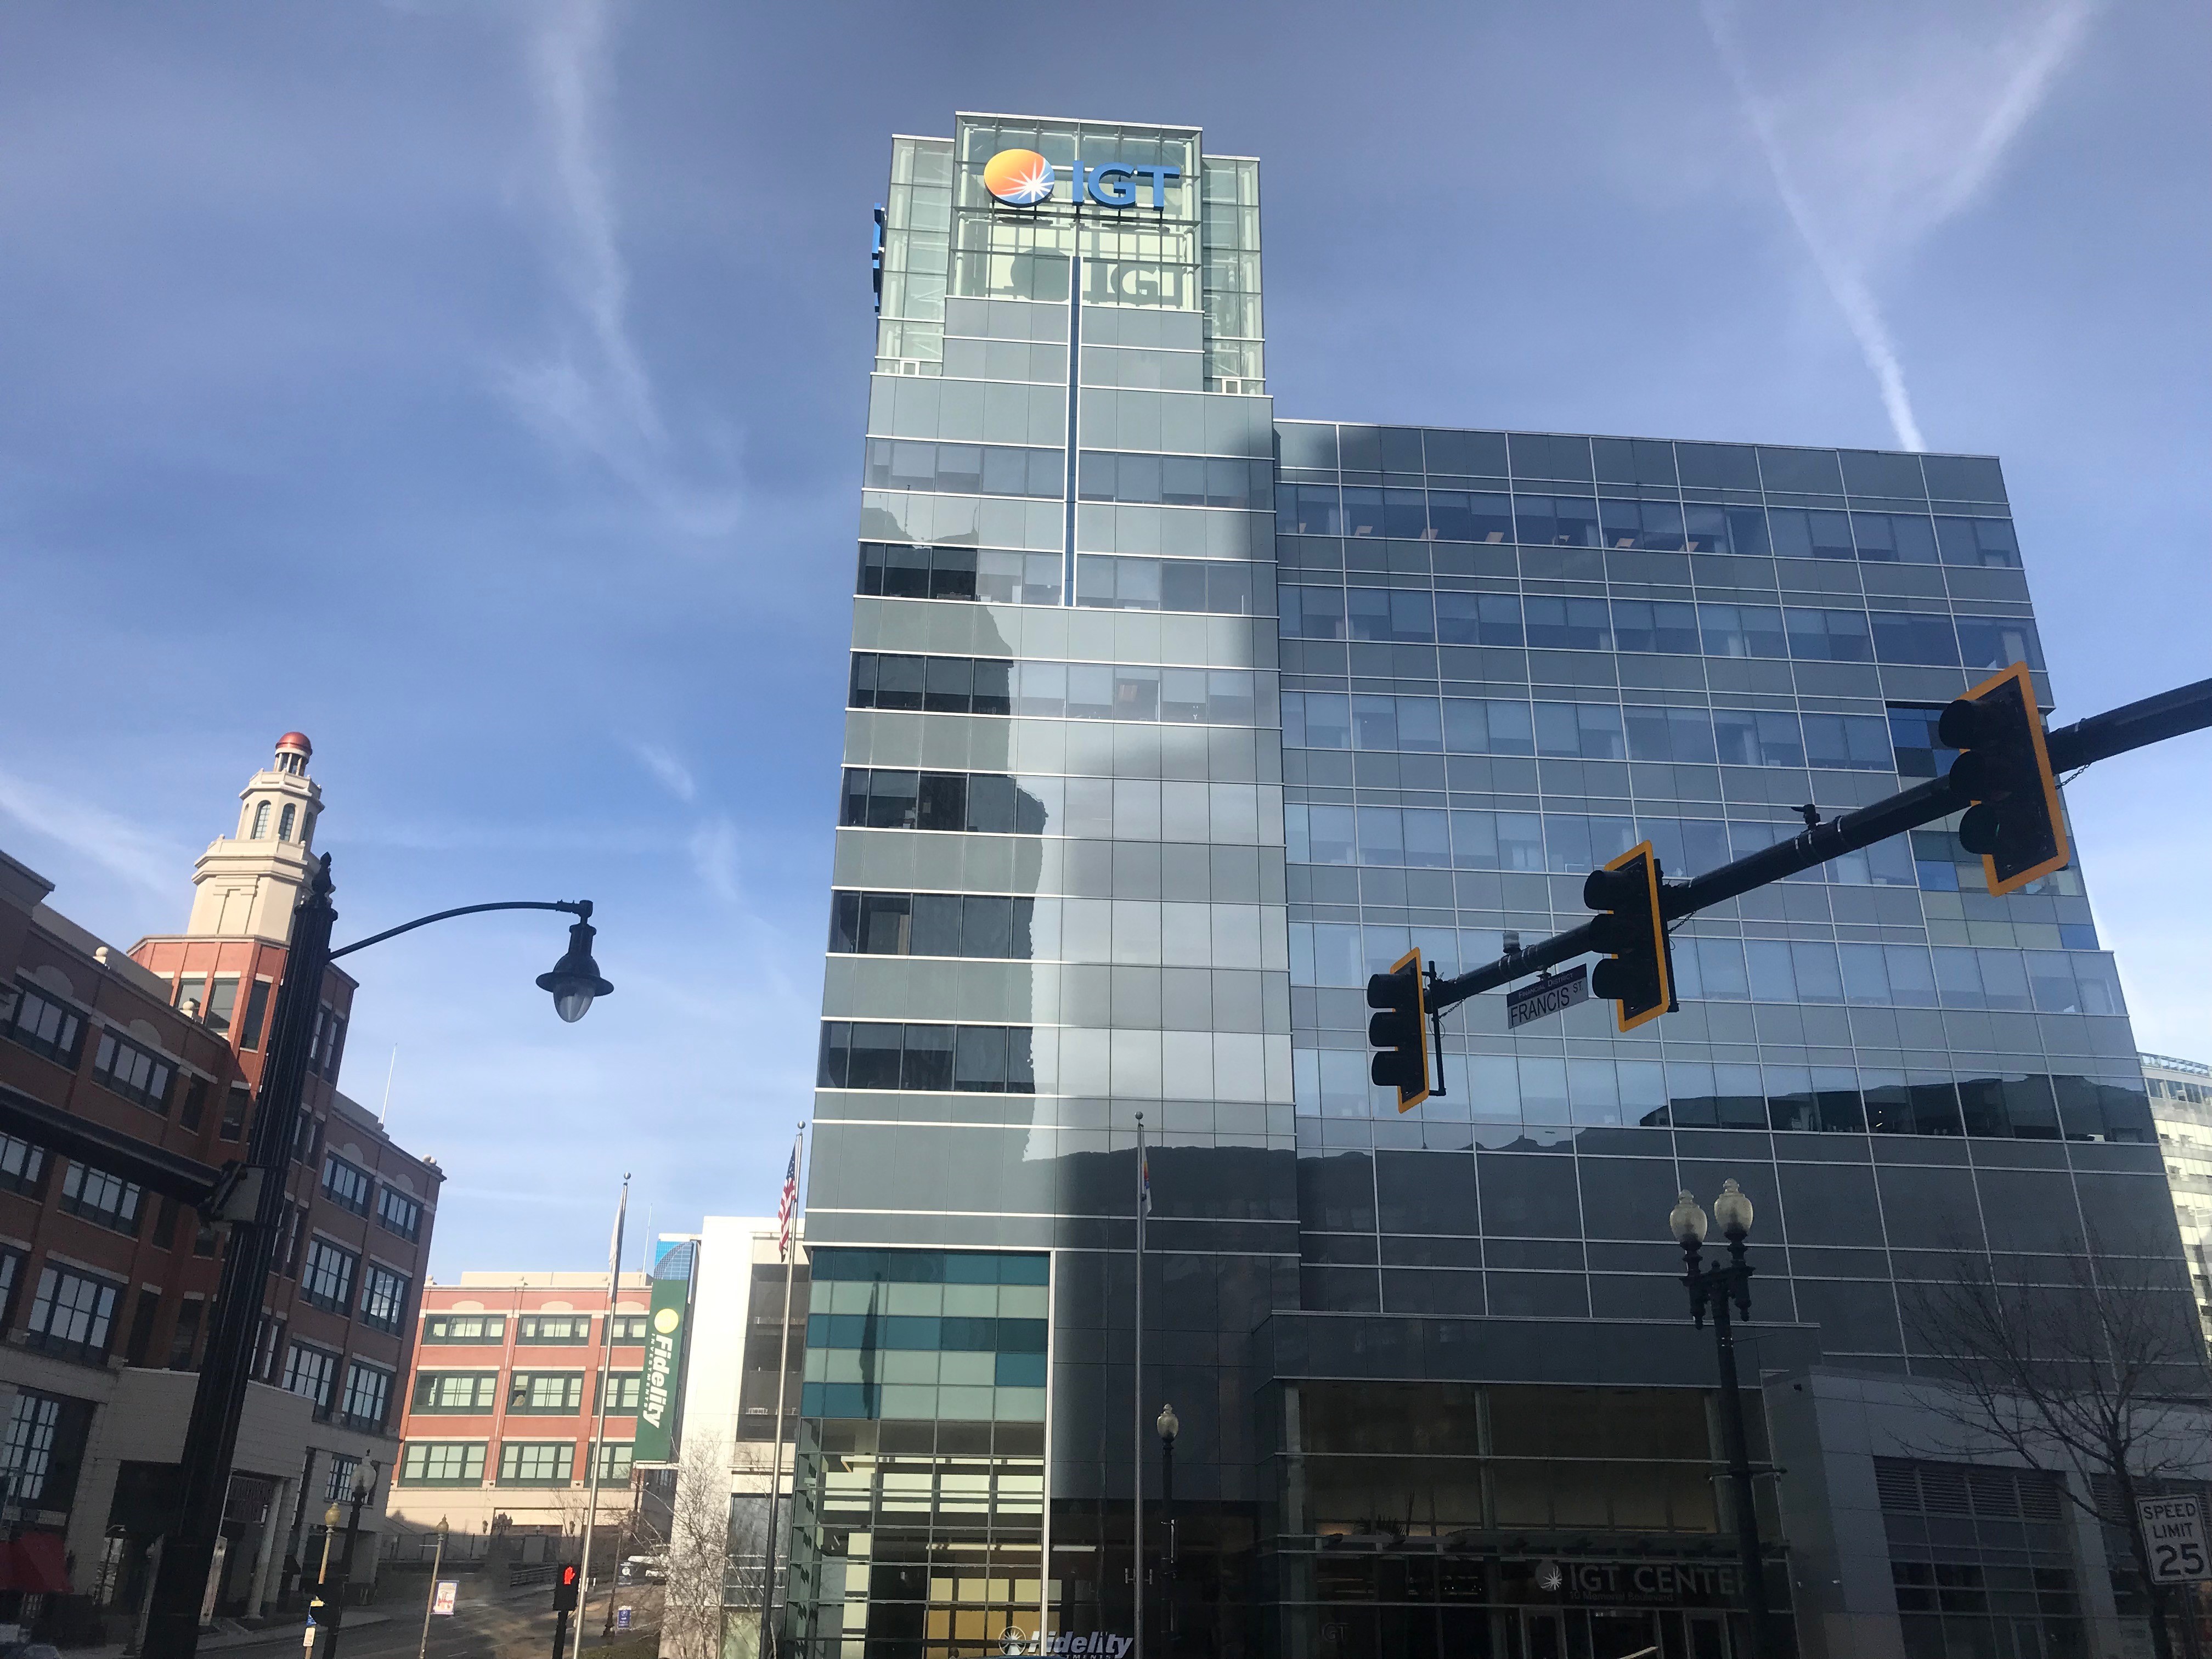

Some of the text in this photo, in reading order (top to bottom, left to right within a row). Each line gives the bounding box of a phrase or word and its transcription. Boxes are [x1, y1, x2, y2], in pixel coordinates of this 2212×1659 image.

[1072, 160, 1180, 211] IGT
[1548, 973, 1573, 987] DISTRICT
[1510, 980, 1584, 1026] FRANCIS ST.
[643, 1334, 673, 1429] Fidelity
[644, 1333, 656, 1408] INVESTMENTS
[2143, 1503, 2196, 1520] SPEED
[2153, 1522, 2193, 1538] LIMIT
[2155, 1543, 2204, 1576] 25
[1569, 1564, 1620, 1593] IGT
